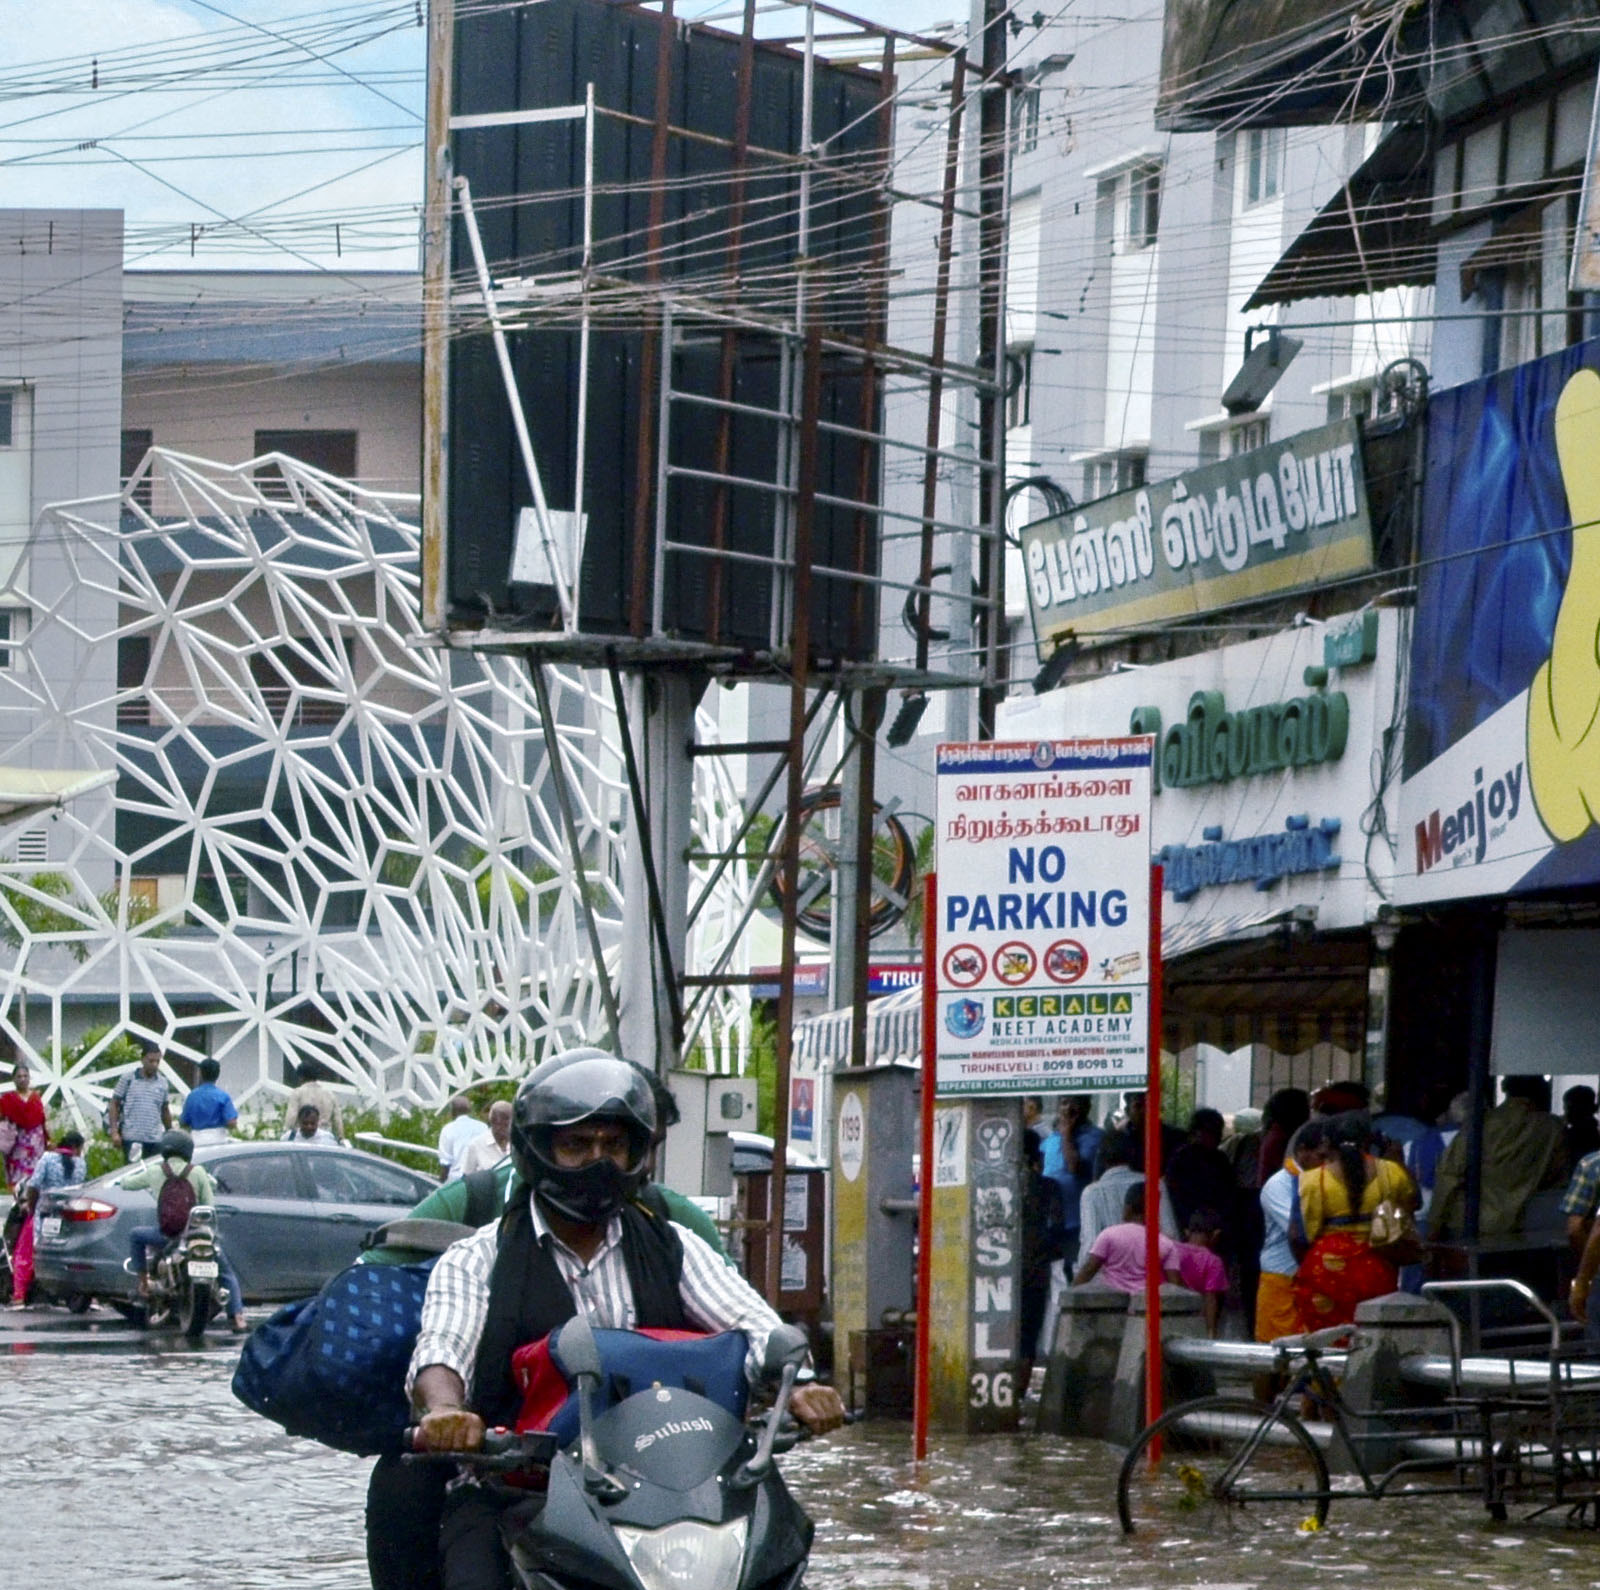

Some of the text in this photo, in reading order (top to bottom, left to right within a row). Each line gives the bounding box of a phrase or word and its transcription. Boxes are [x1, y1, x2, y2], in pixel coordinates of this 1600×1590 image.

[955, 775, 1132, 801] வாகனங்களை
[946, 810, 1140, 843] நிறுத்தக்கூடாது
[1415, 762, 1523, 876] Menjoy
[1009, 846, 1066, 884] NO
[947, 889, 1128, 932] PARKING
[993, 993, 1132, 1018] KERALA
[993, 1017, 1132, 1037] NEET ACADEMY
[961, 1058, 1123, 1073] TIRUNELVELI 8098 8098 12
[1052, 1078, 1082, 1088] CRASH
[1092, 1077, 1112, 1086] TEST
[1115, 1075, 1146, 1085] SERIES
[974, 1187, 1013, 1358] BSNL
[970, 1372, 1013, 1408] 3G
[634, 1416, 714, 1452] Subash
